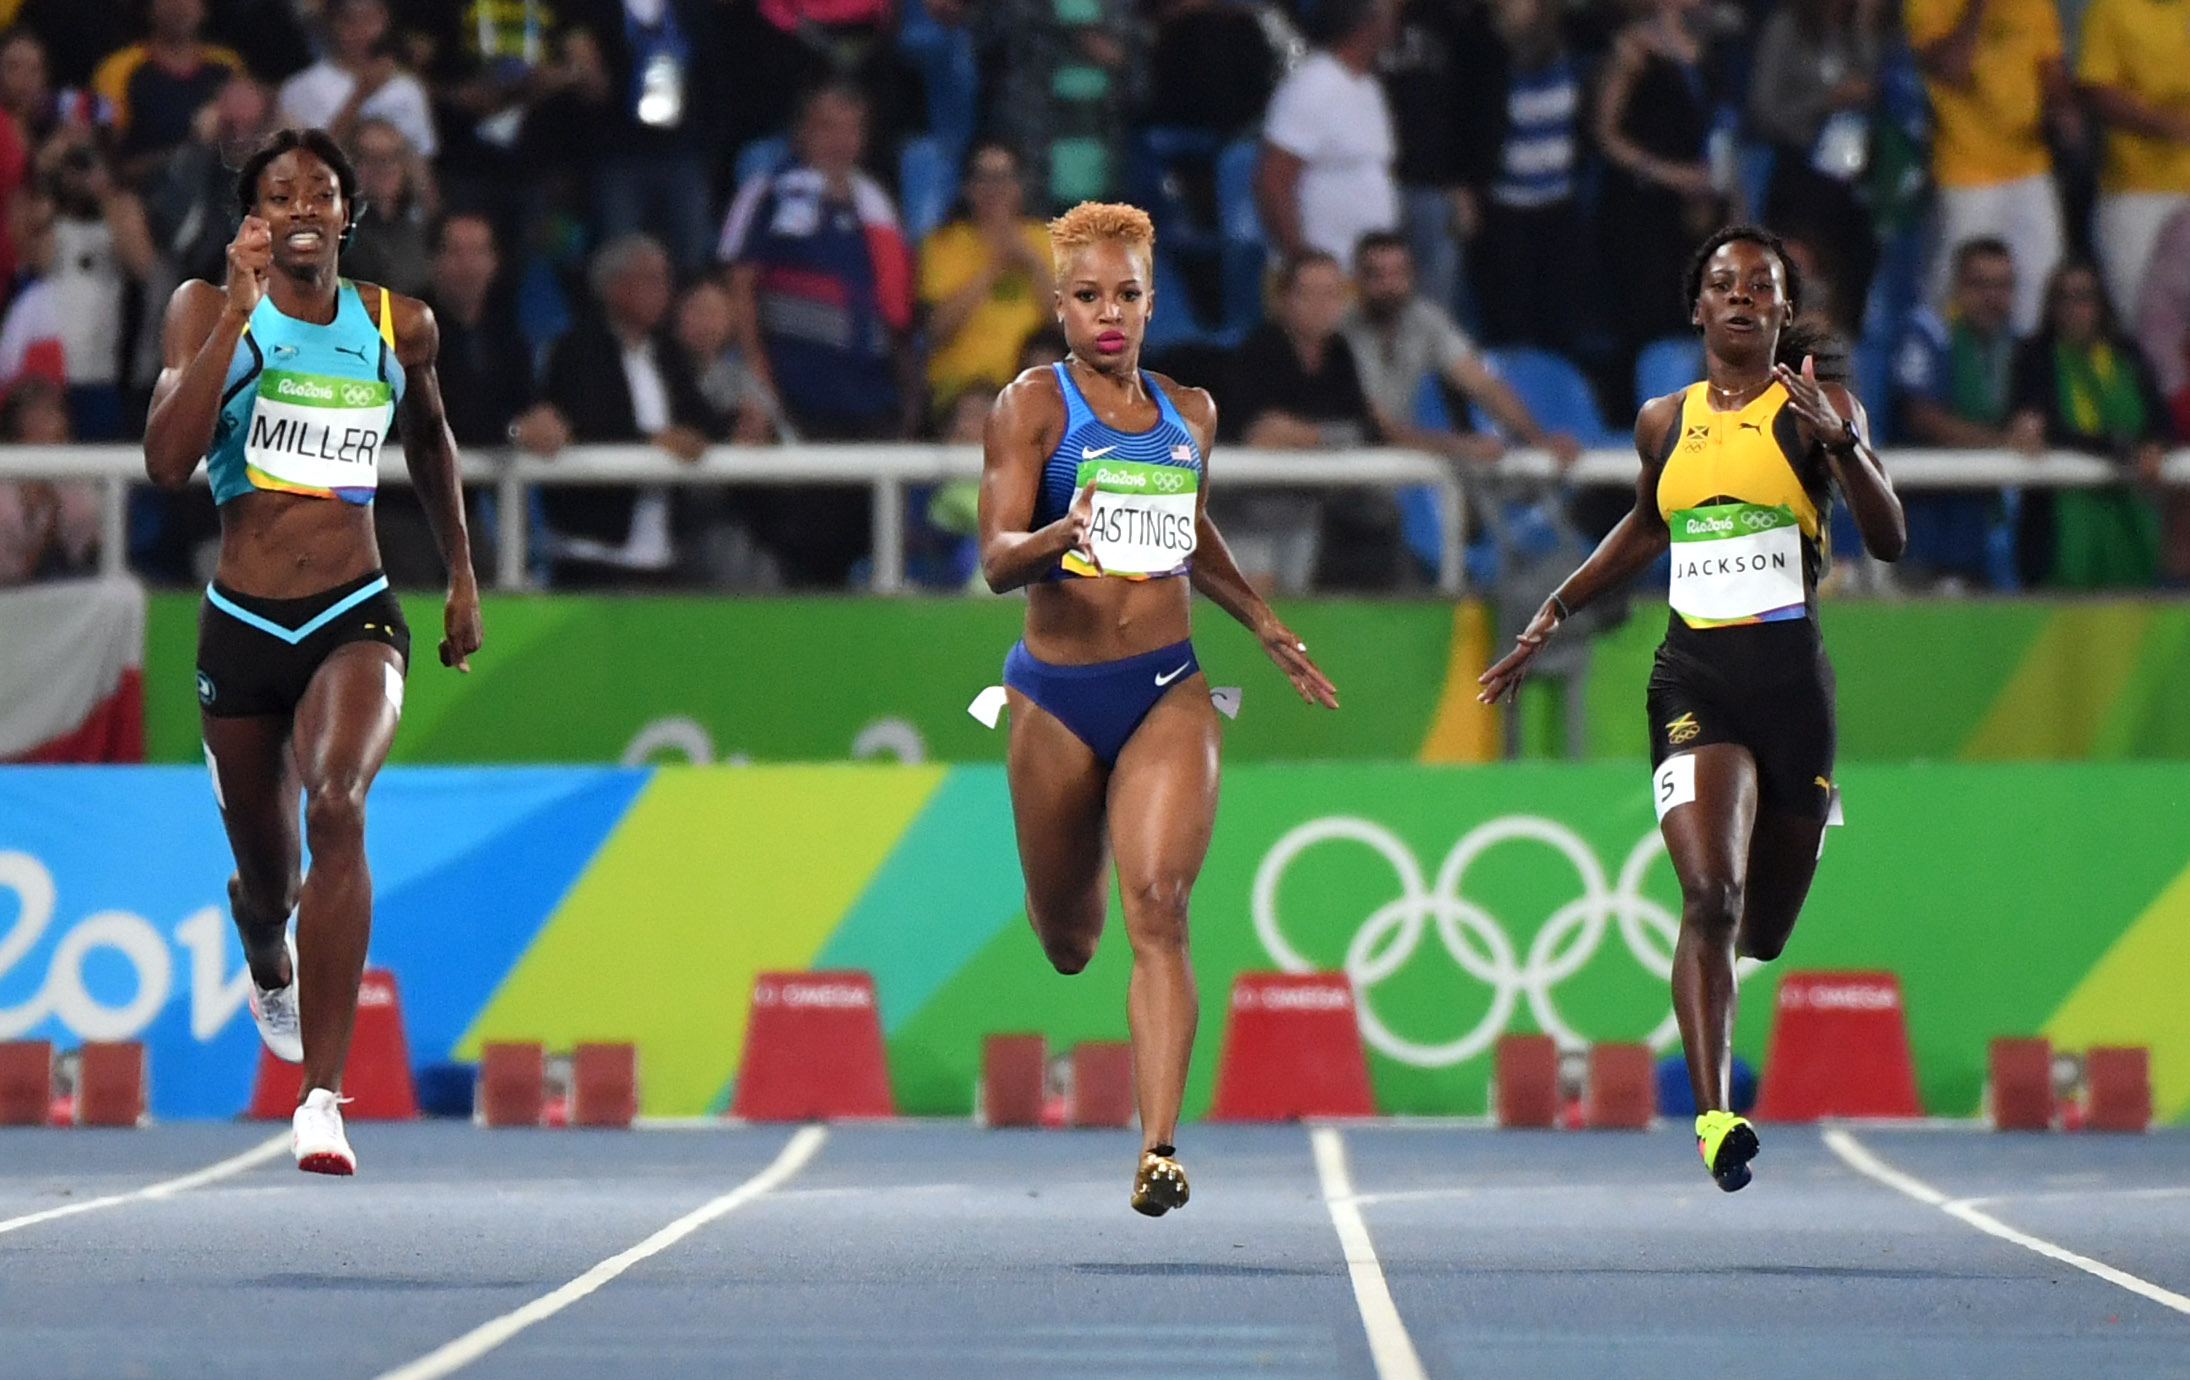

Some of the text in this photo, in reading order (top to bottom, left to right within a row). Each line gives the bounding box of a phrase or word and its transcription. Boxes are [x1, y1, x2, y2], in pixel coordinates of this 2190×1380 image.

[278, 378, 334, 400] Rio2016
[250, 415, 379, 466] MILLER
[1096, 468, 1147, 487] Rio2016
[1088, 506, 1193, 551] ASTINGS
[1686, 515, 1734, 534] Rio2016
[1676, 551, 1786, 579] JACKSON
[1661, 770, 1675, 803] 5
